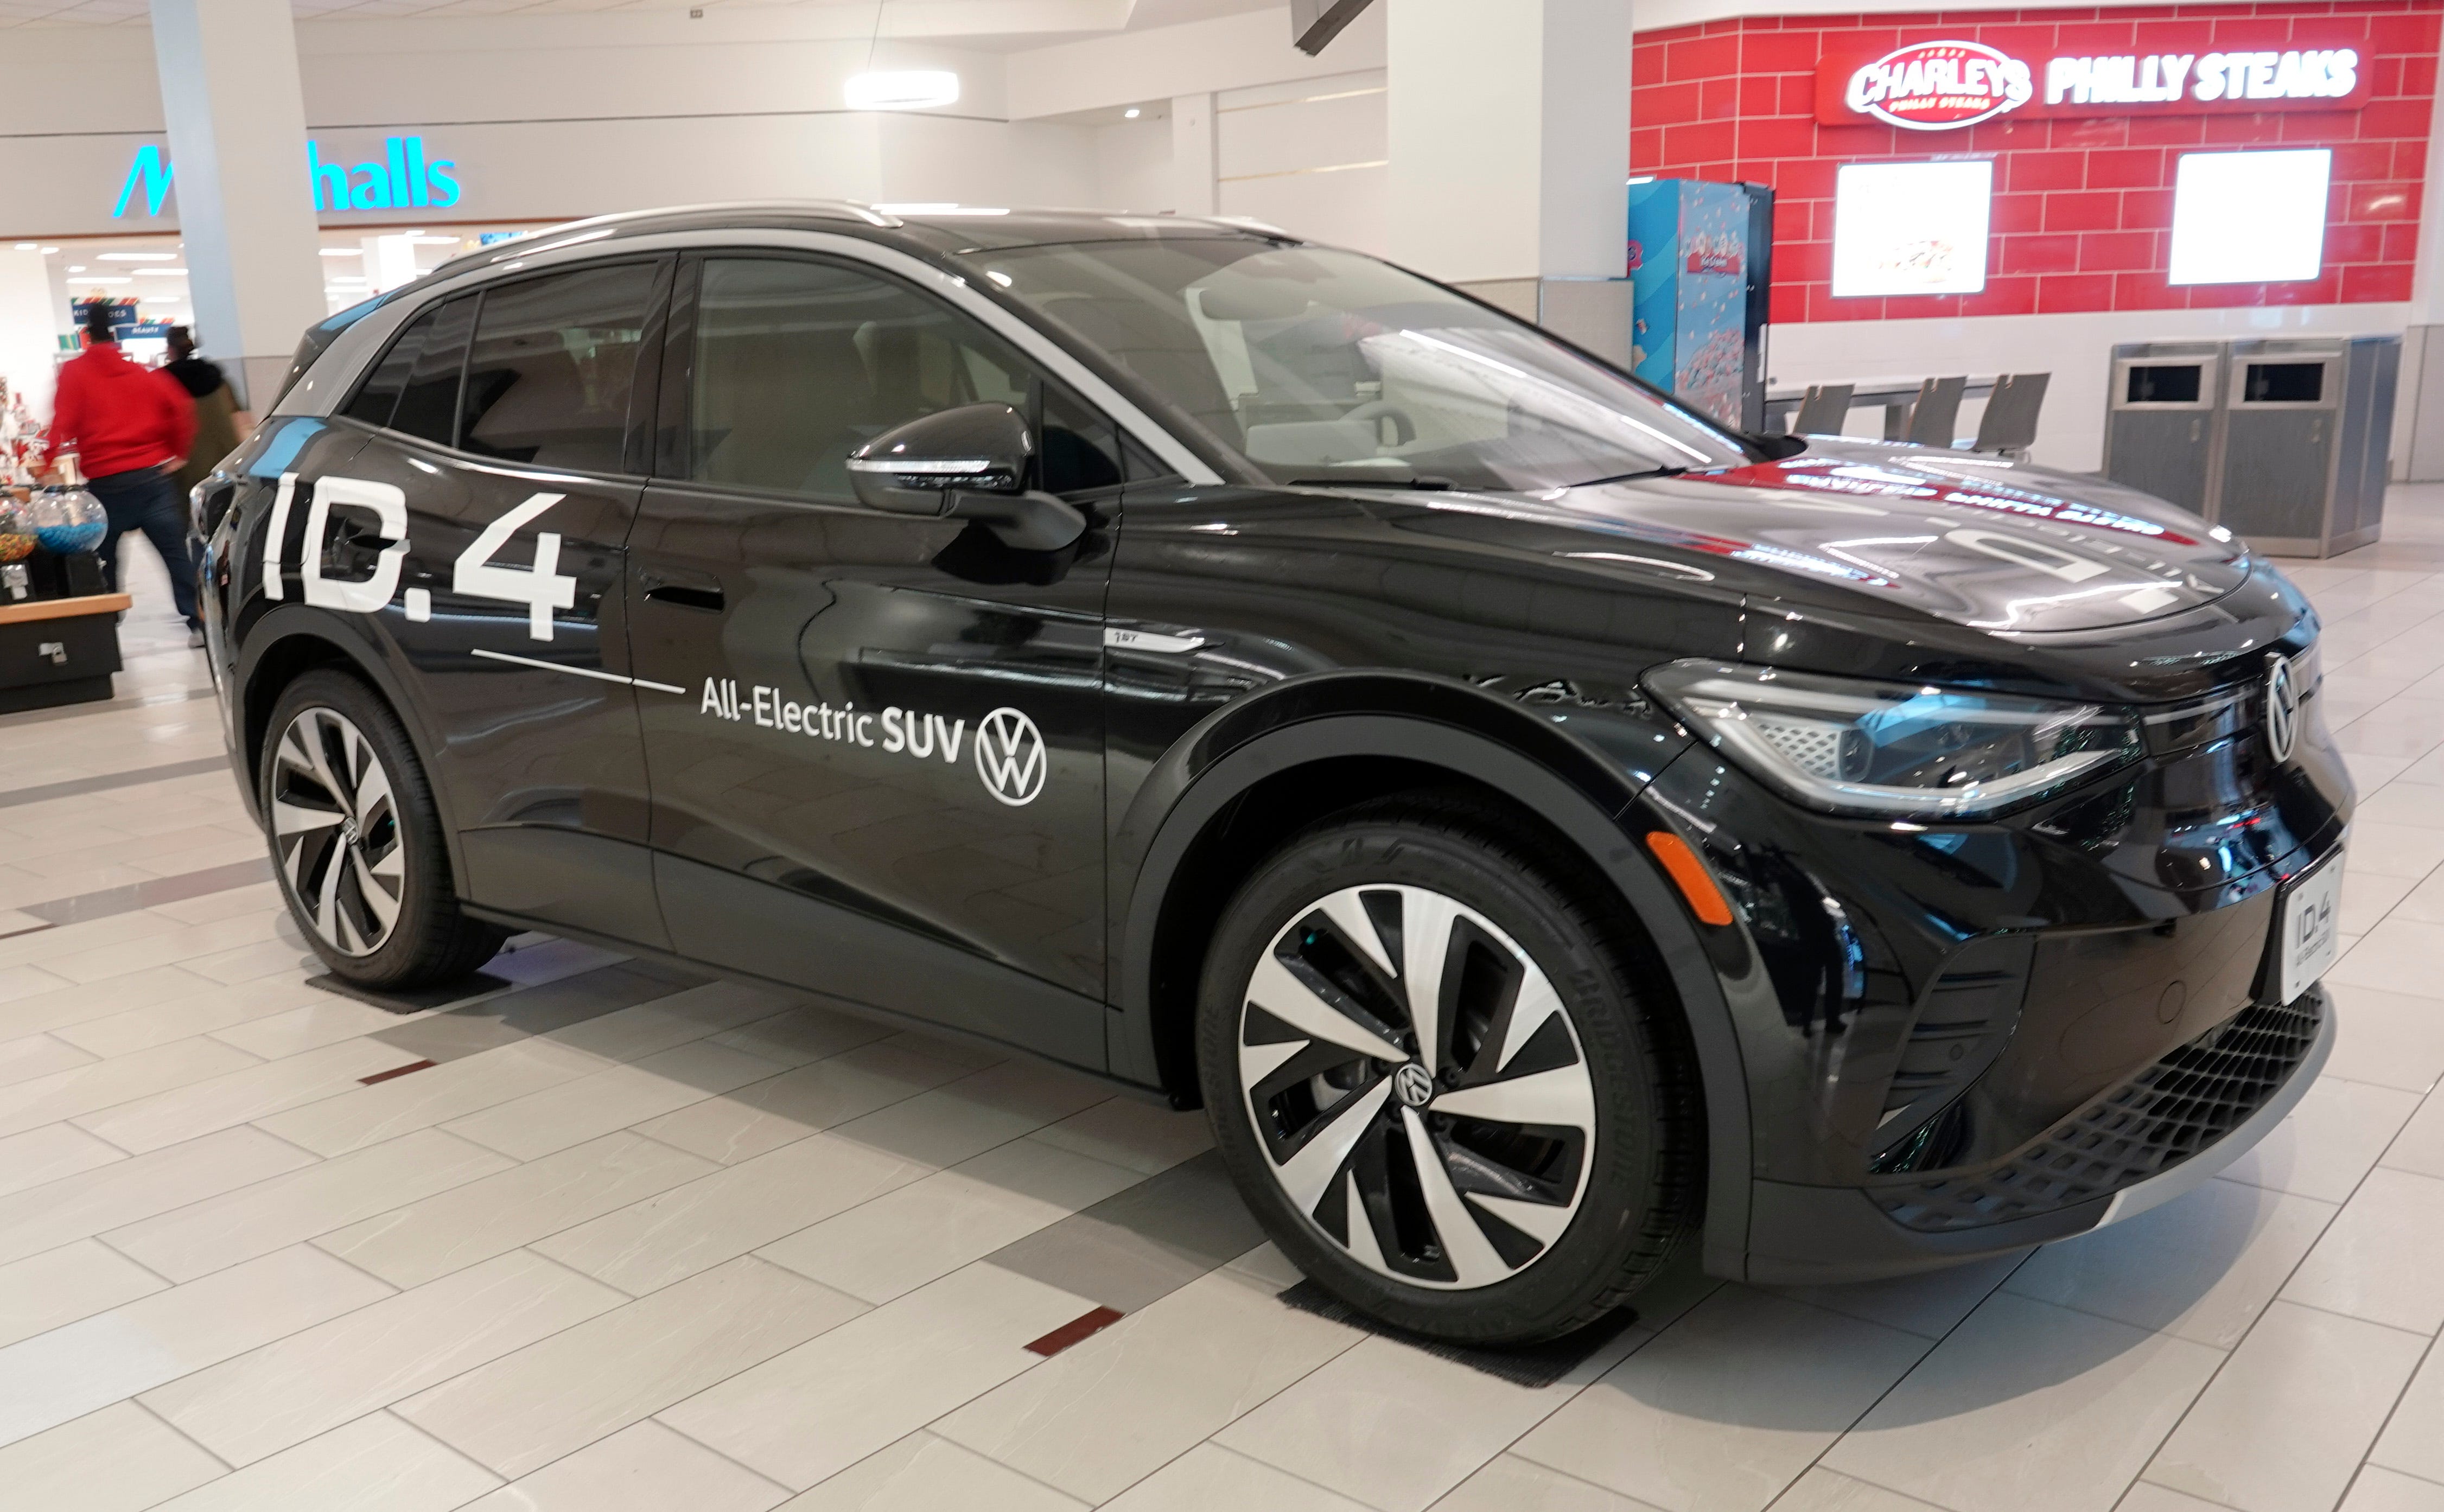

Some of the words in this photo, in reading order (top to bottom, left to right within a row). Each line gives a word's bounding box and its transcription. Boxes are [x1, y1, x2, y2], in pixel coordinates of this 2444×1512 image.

[1847, 58, 2033, 112] CHARLEYS
[2044, 55, 2194, 104] PHILLY
[2191, 49, 2358, 101] STEAKS
[112, 136, 461, 218] Mhalls
[263, 472, 577, 642] ID.4
[701, 677, 875, 748] All-Electric
[881, 706, 965, 764] SUV
[2296, 890, 2332, 949] ID.4
